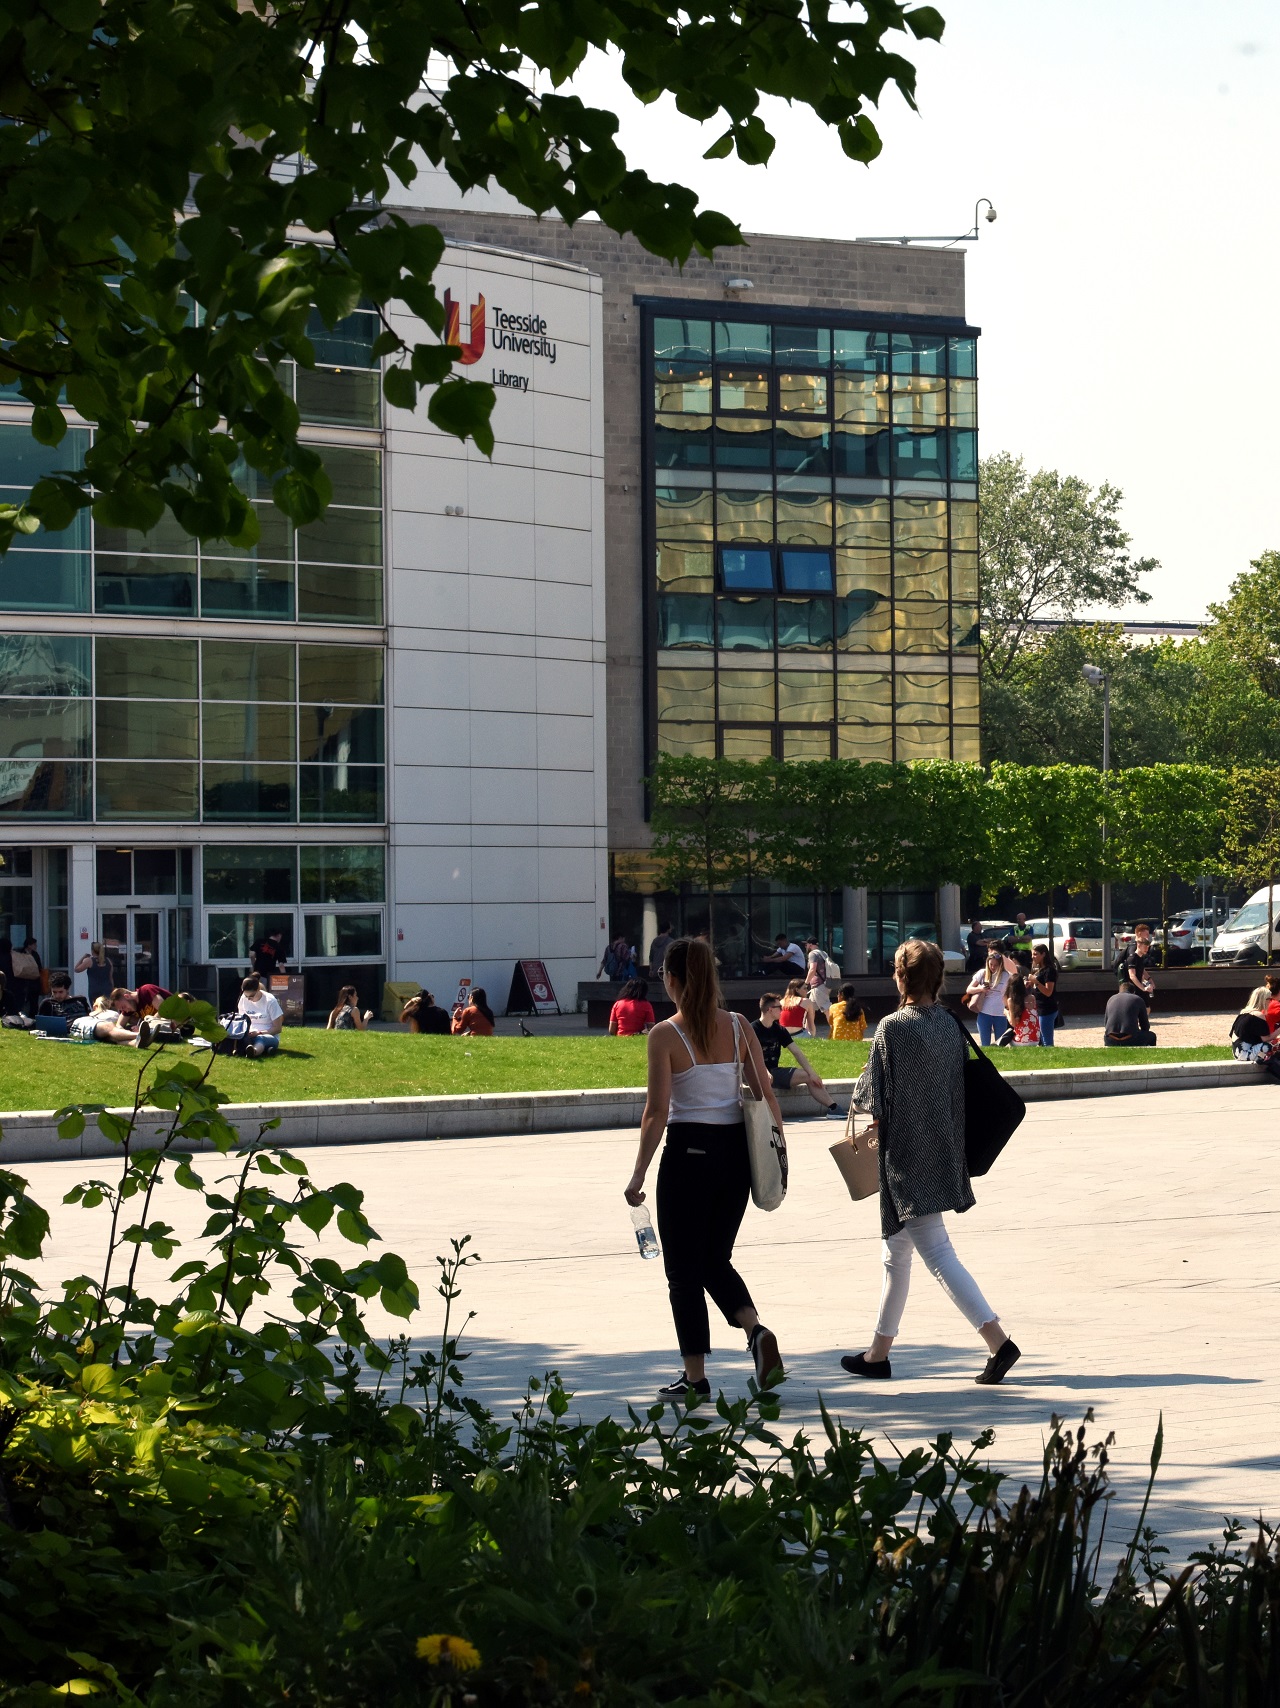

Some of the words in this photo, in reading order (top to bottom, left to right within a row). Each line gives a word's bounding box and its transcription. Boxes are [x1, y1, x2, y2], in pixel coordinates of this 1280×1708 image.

[492, 306, 547, 336] Teesside
[492, 328, 556, 364] University
[492, 368, 529, 393] Library
